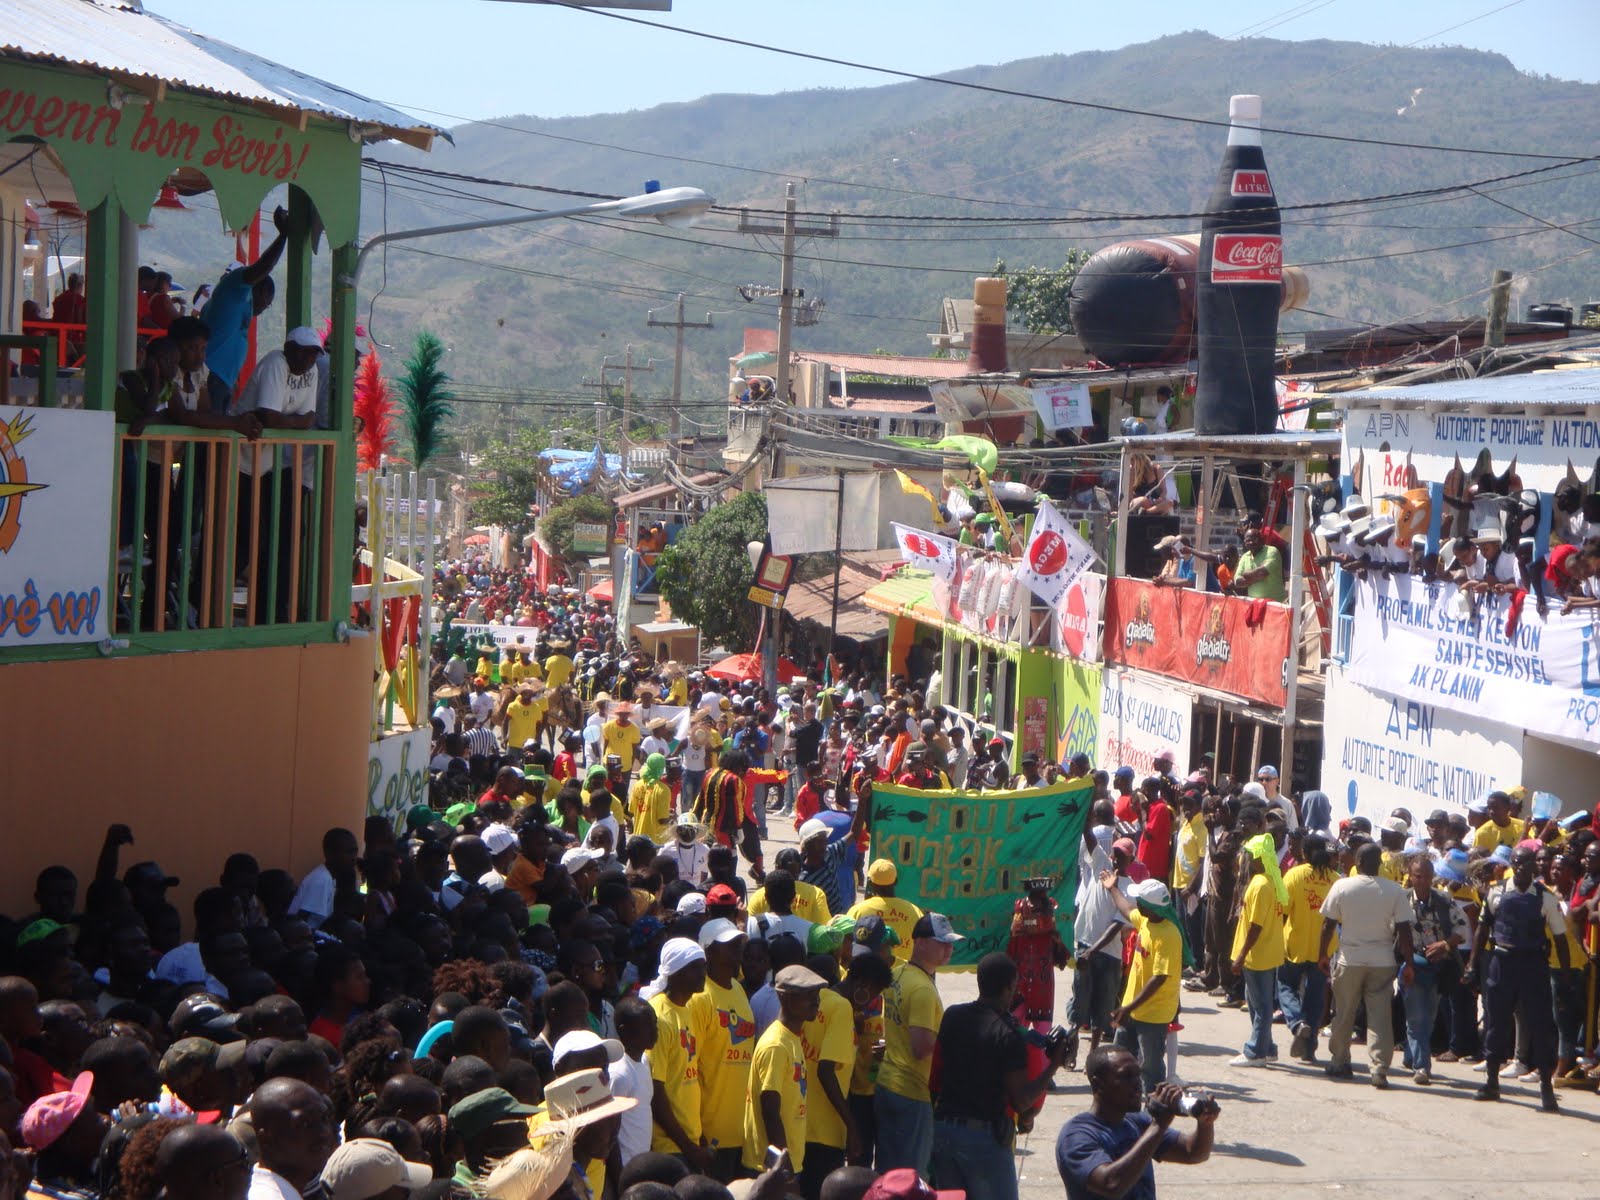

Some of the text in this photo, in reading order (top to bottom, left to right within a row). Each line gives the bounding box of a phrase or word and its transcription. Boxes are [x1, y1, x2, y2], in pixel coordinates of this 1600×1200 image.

[131, 102, 200, 161] bon
[1238, 183, 1268, 193] LITRE
[1365, 413, 1410, 437] APN
[1435, 416, 1485, 443] AUTORITE
[1490, 418, 1545, 446] PORTUAIRE
[1376, 595, 1434, 630] PROFAMIL
[1196, 633, 1231, 666] gladiator
[1435, 638, 1483, 671] SANTE
[1408, 664, 1485, 704] AK PLANIN
[1103, 686, 1124, 719] BUS
[1136, 701, 1183, 744] CHARLES
[1385, 698, 1435, 748] APN
[1342, 737, 1385, 780] AUTORITE
[1388, 749, 1439, 798] PORTUAIRE
[727, 1049, 740, 1060] 20
